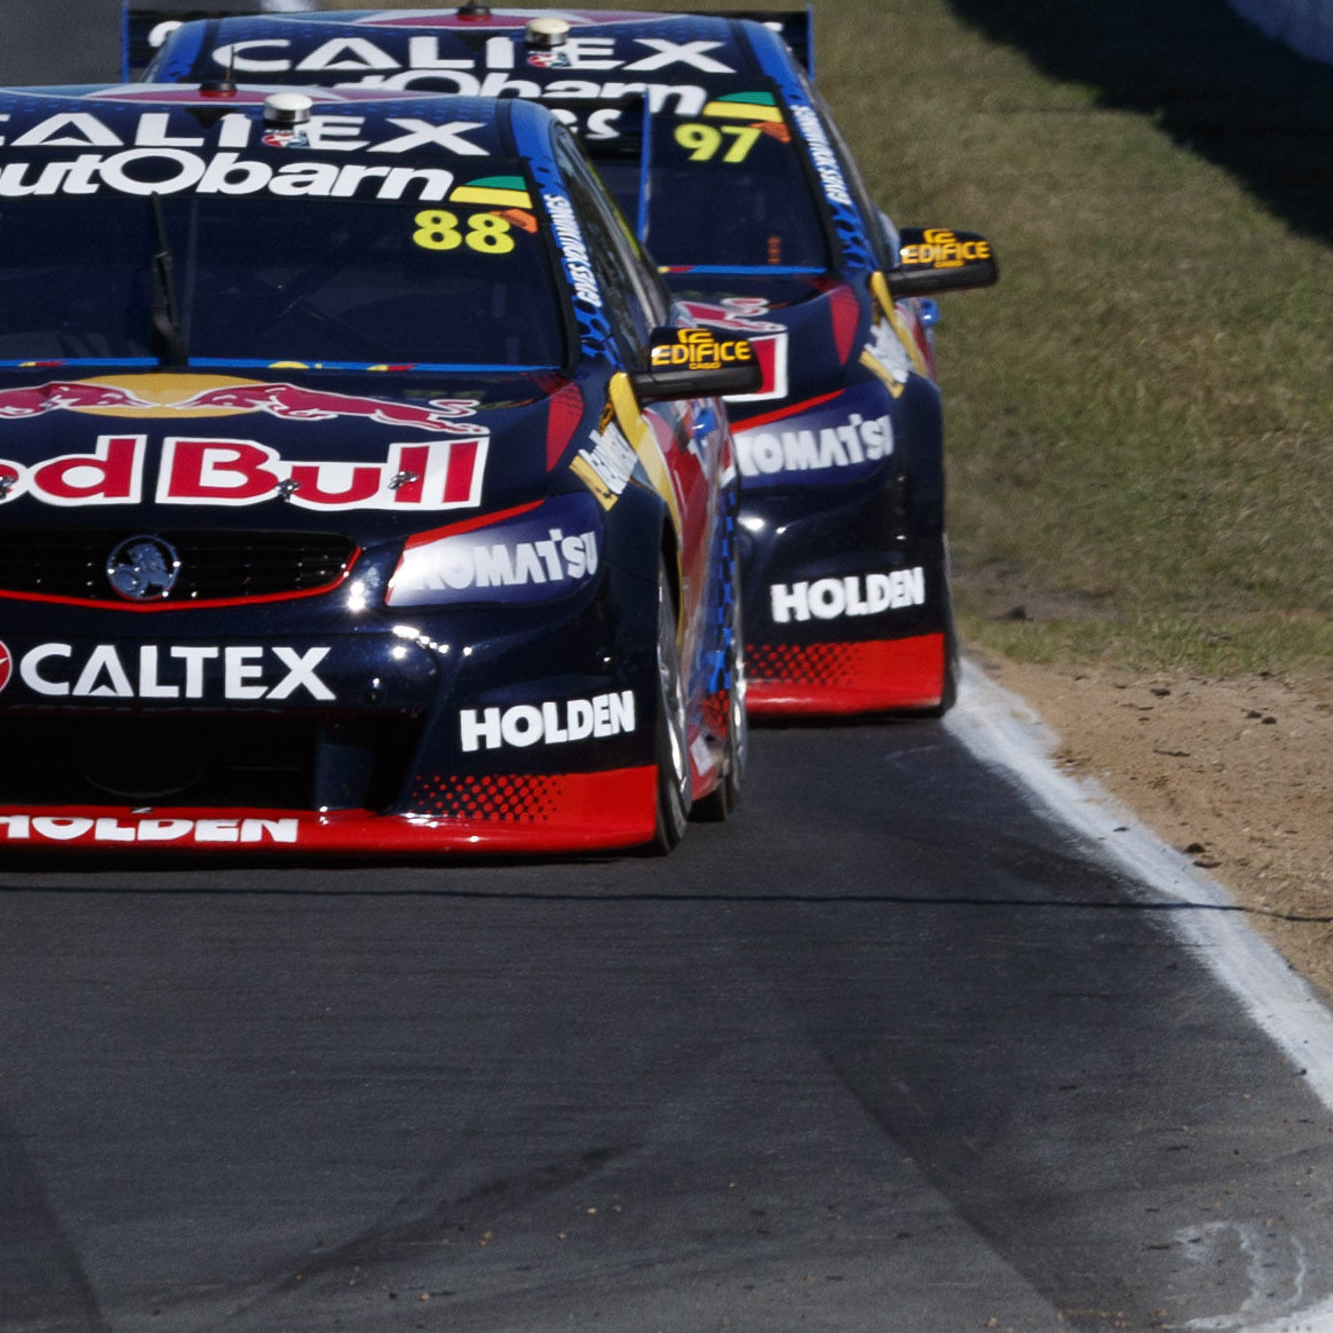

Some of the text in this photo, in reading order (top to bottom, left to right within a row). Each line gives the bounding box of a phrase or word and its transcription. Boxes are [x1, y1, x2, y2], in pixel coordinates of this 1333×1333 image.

[674, 122, 763, 163] 97
[412, 209, 516, 256] 88
[900, 240, 992, 265] EDIFICE
[650, 340, 752, 366] EDIFICE
[154, 435, 490, 512] Bull
[770, 566, 926, 624] HOLDEN
[20, 642, 337, 702] CALTEX
[460, 688, 636, 752] HOLDEN
